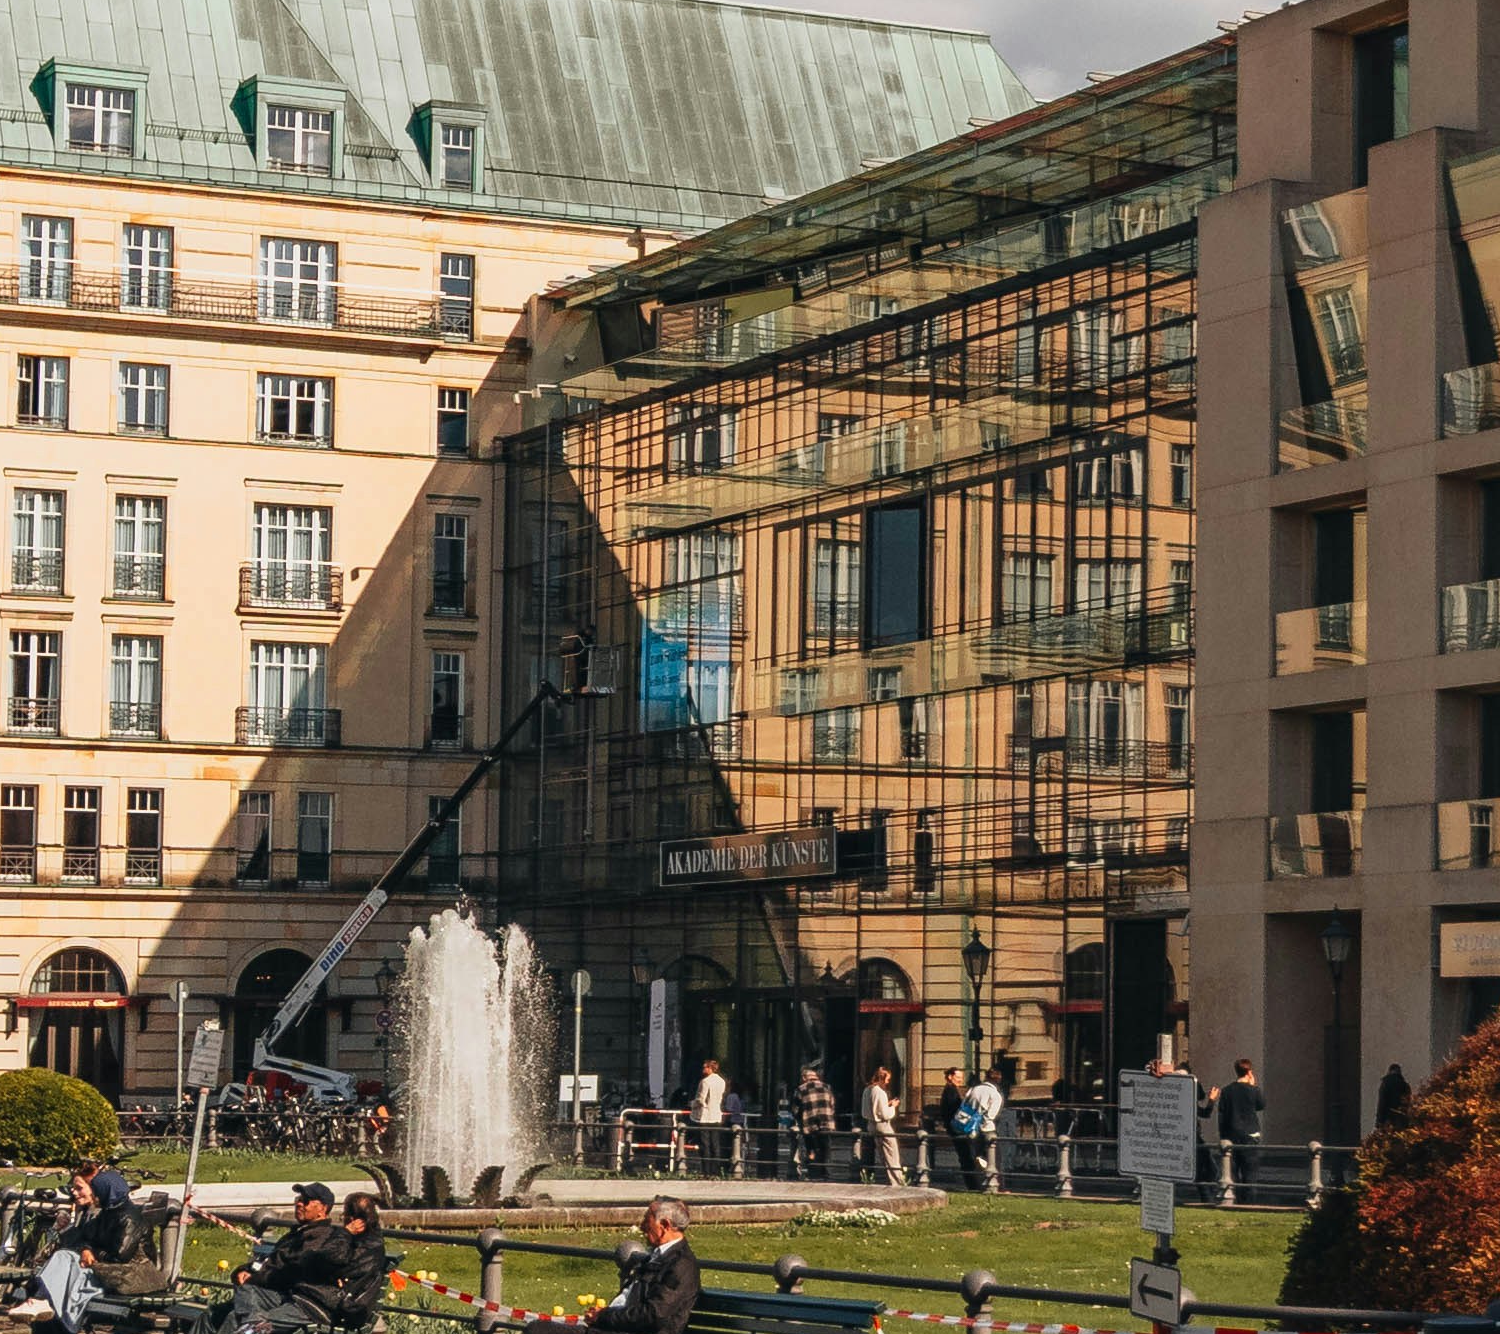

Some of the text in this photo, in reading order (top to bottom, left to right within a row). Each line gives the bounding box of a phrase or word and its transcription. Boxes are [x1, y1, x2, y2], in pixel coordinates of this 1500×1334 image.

[666, 836, 830, 876] AKADEMIE DER KÜNSTE
